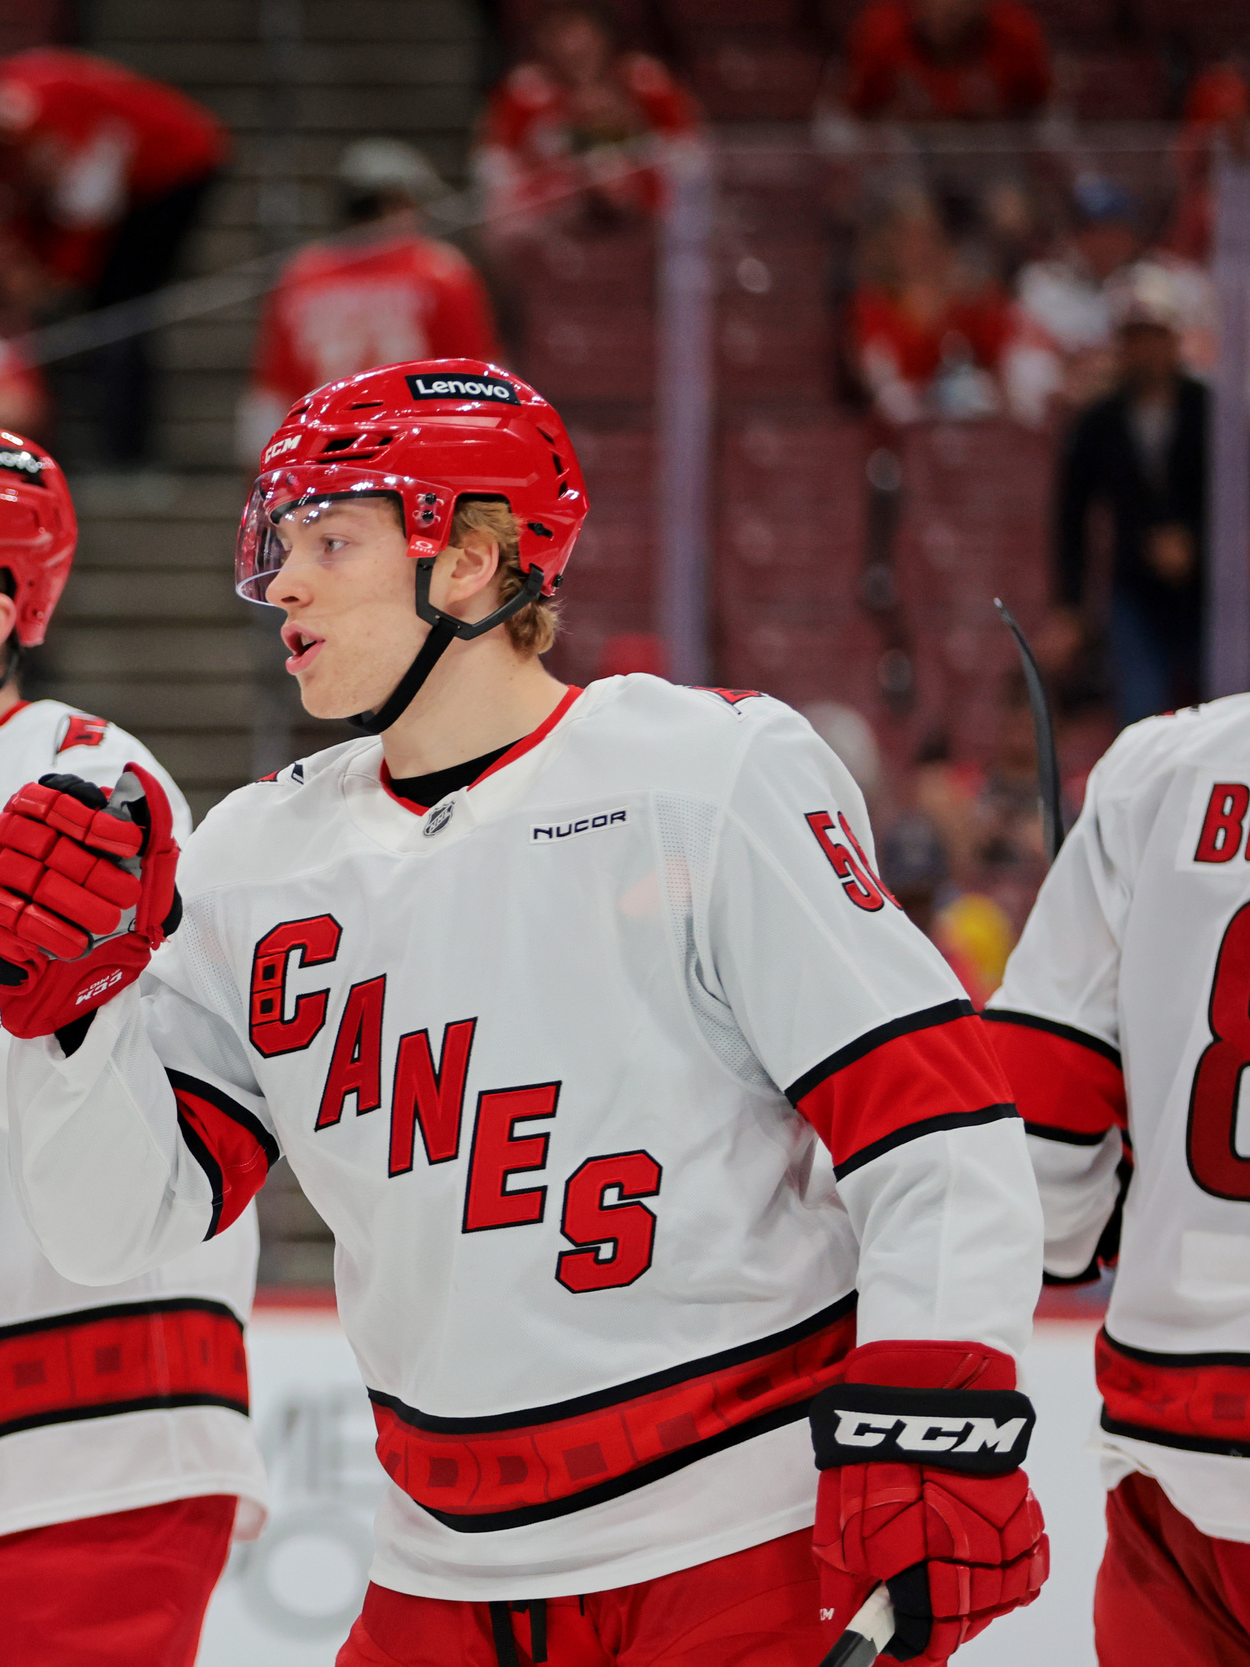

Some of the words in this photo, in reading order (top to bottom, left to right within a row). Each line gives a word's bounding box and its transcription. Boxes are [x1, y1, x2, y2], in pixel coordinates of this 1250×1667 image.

[415, 379, 511, 400] Lenovo
[264, 434, 303, 465] CCM
[532, 809, 627, 841] NUCOR
[1193, 782, 1250, 865] B
[803, 810, 904, 912] 5
[75, 971, 123, 1005] CCM
[249, 912, 664, 1295] CANES
[833, 1409, 1027, 1453] CCM
